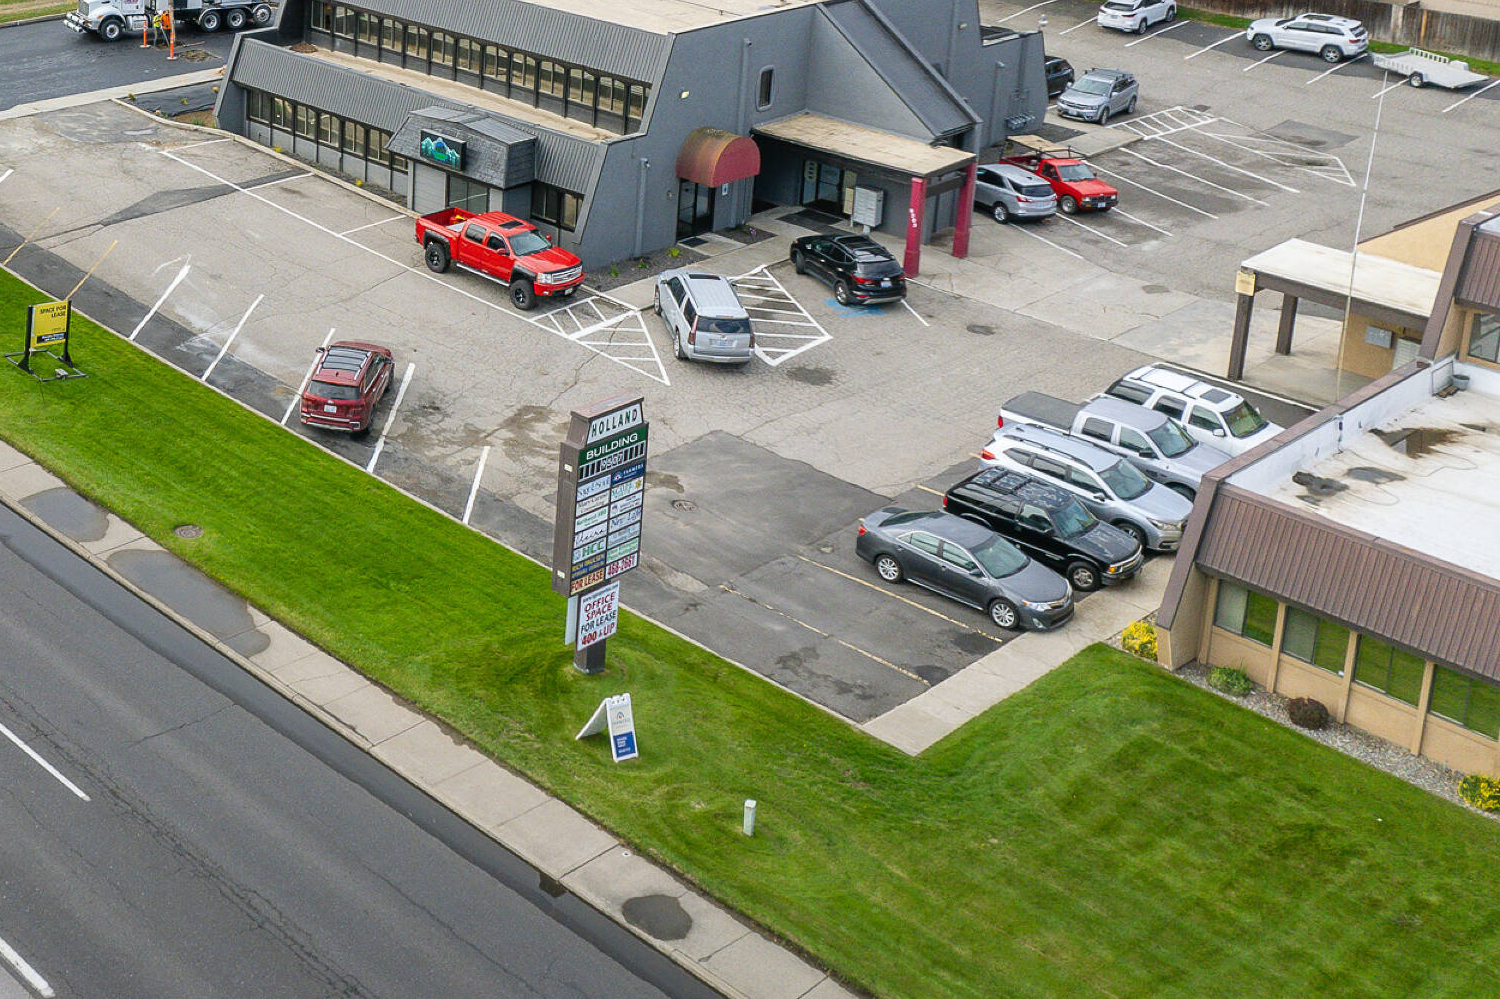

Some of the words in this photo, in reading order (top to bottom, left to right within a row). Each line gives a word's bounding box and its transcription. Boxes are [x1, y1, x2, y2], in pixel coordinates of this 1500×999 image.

[591, 408, 638, 438] HOLLAND
[586, 433, 638, 460] BUILDING
[571, 579, 583, 591] FOR
[585, 569, 603, 586] LEASE
[584, 591, 616, 613] OFFICE
[586, 602, 613, 622] SPACE
[581, 620, 595, 635] FOR
[596, 609, 617, 626] LEASE
[604, 622, 615, 636] UP
